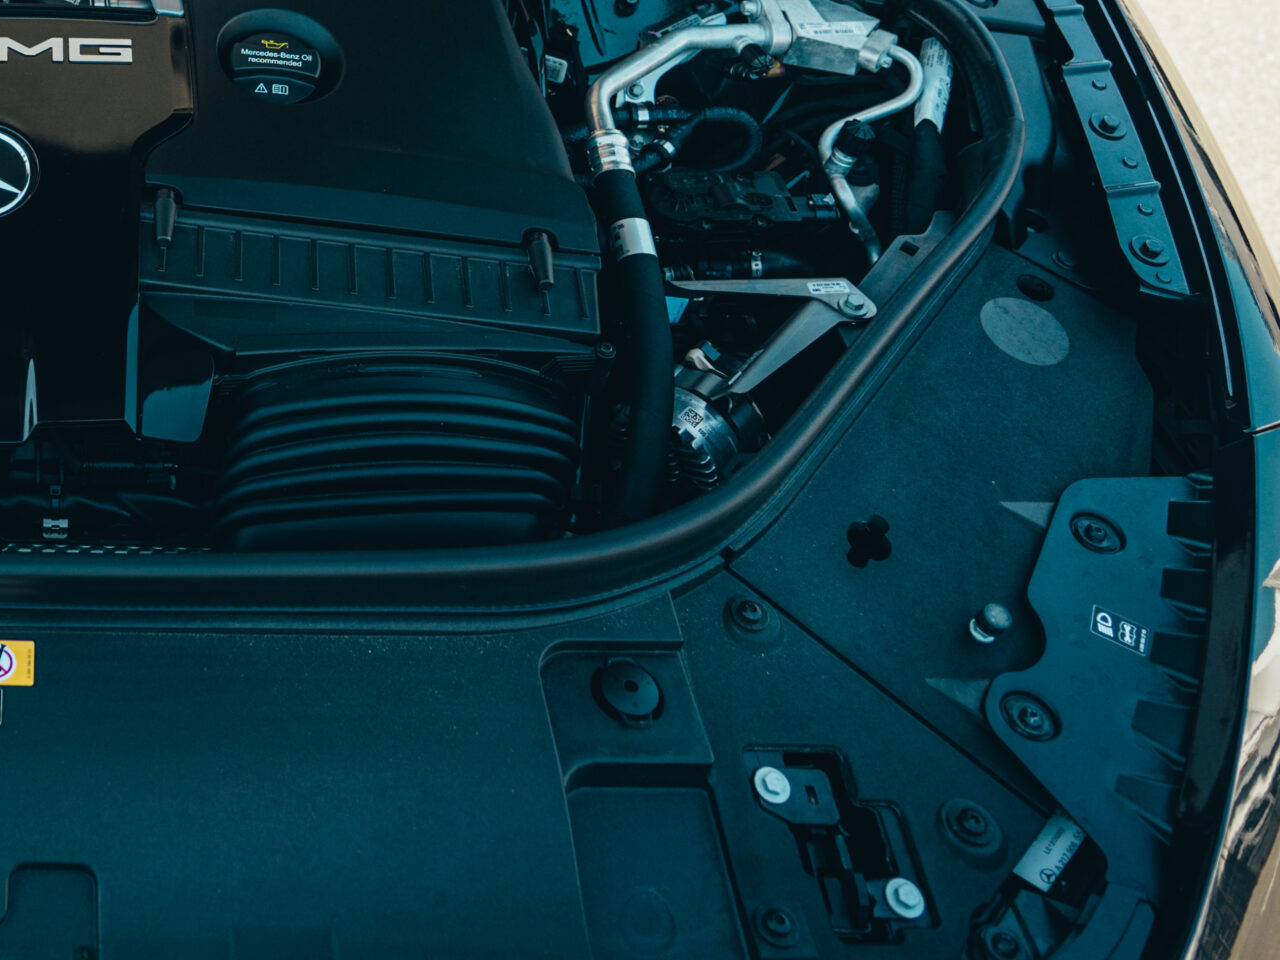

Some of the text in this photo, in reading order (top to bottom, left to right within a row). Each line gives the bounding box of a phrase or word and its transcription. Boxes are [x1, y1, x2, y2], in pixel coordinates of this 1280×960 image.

[241, 48, 313, 62] Mercedes-Benz Oil
[248, 56, 302, 67] recommended
